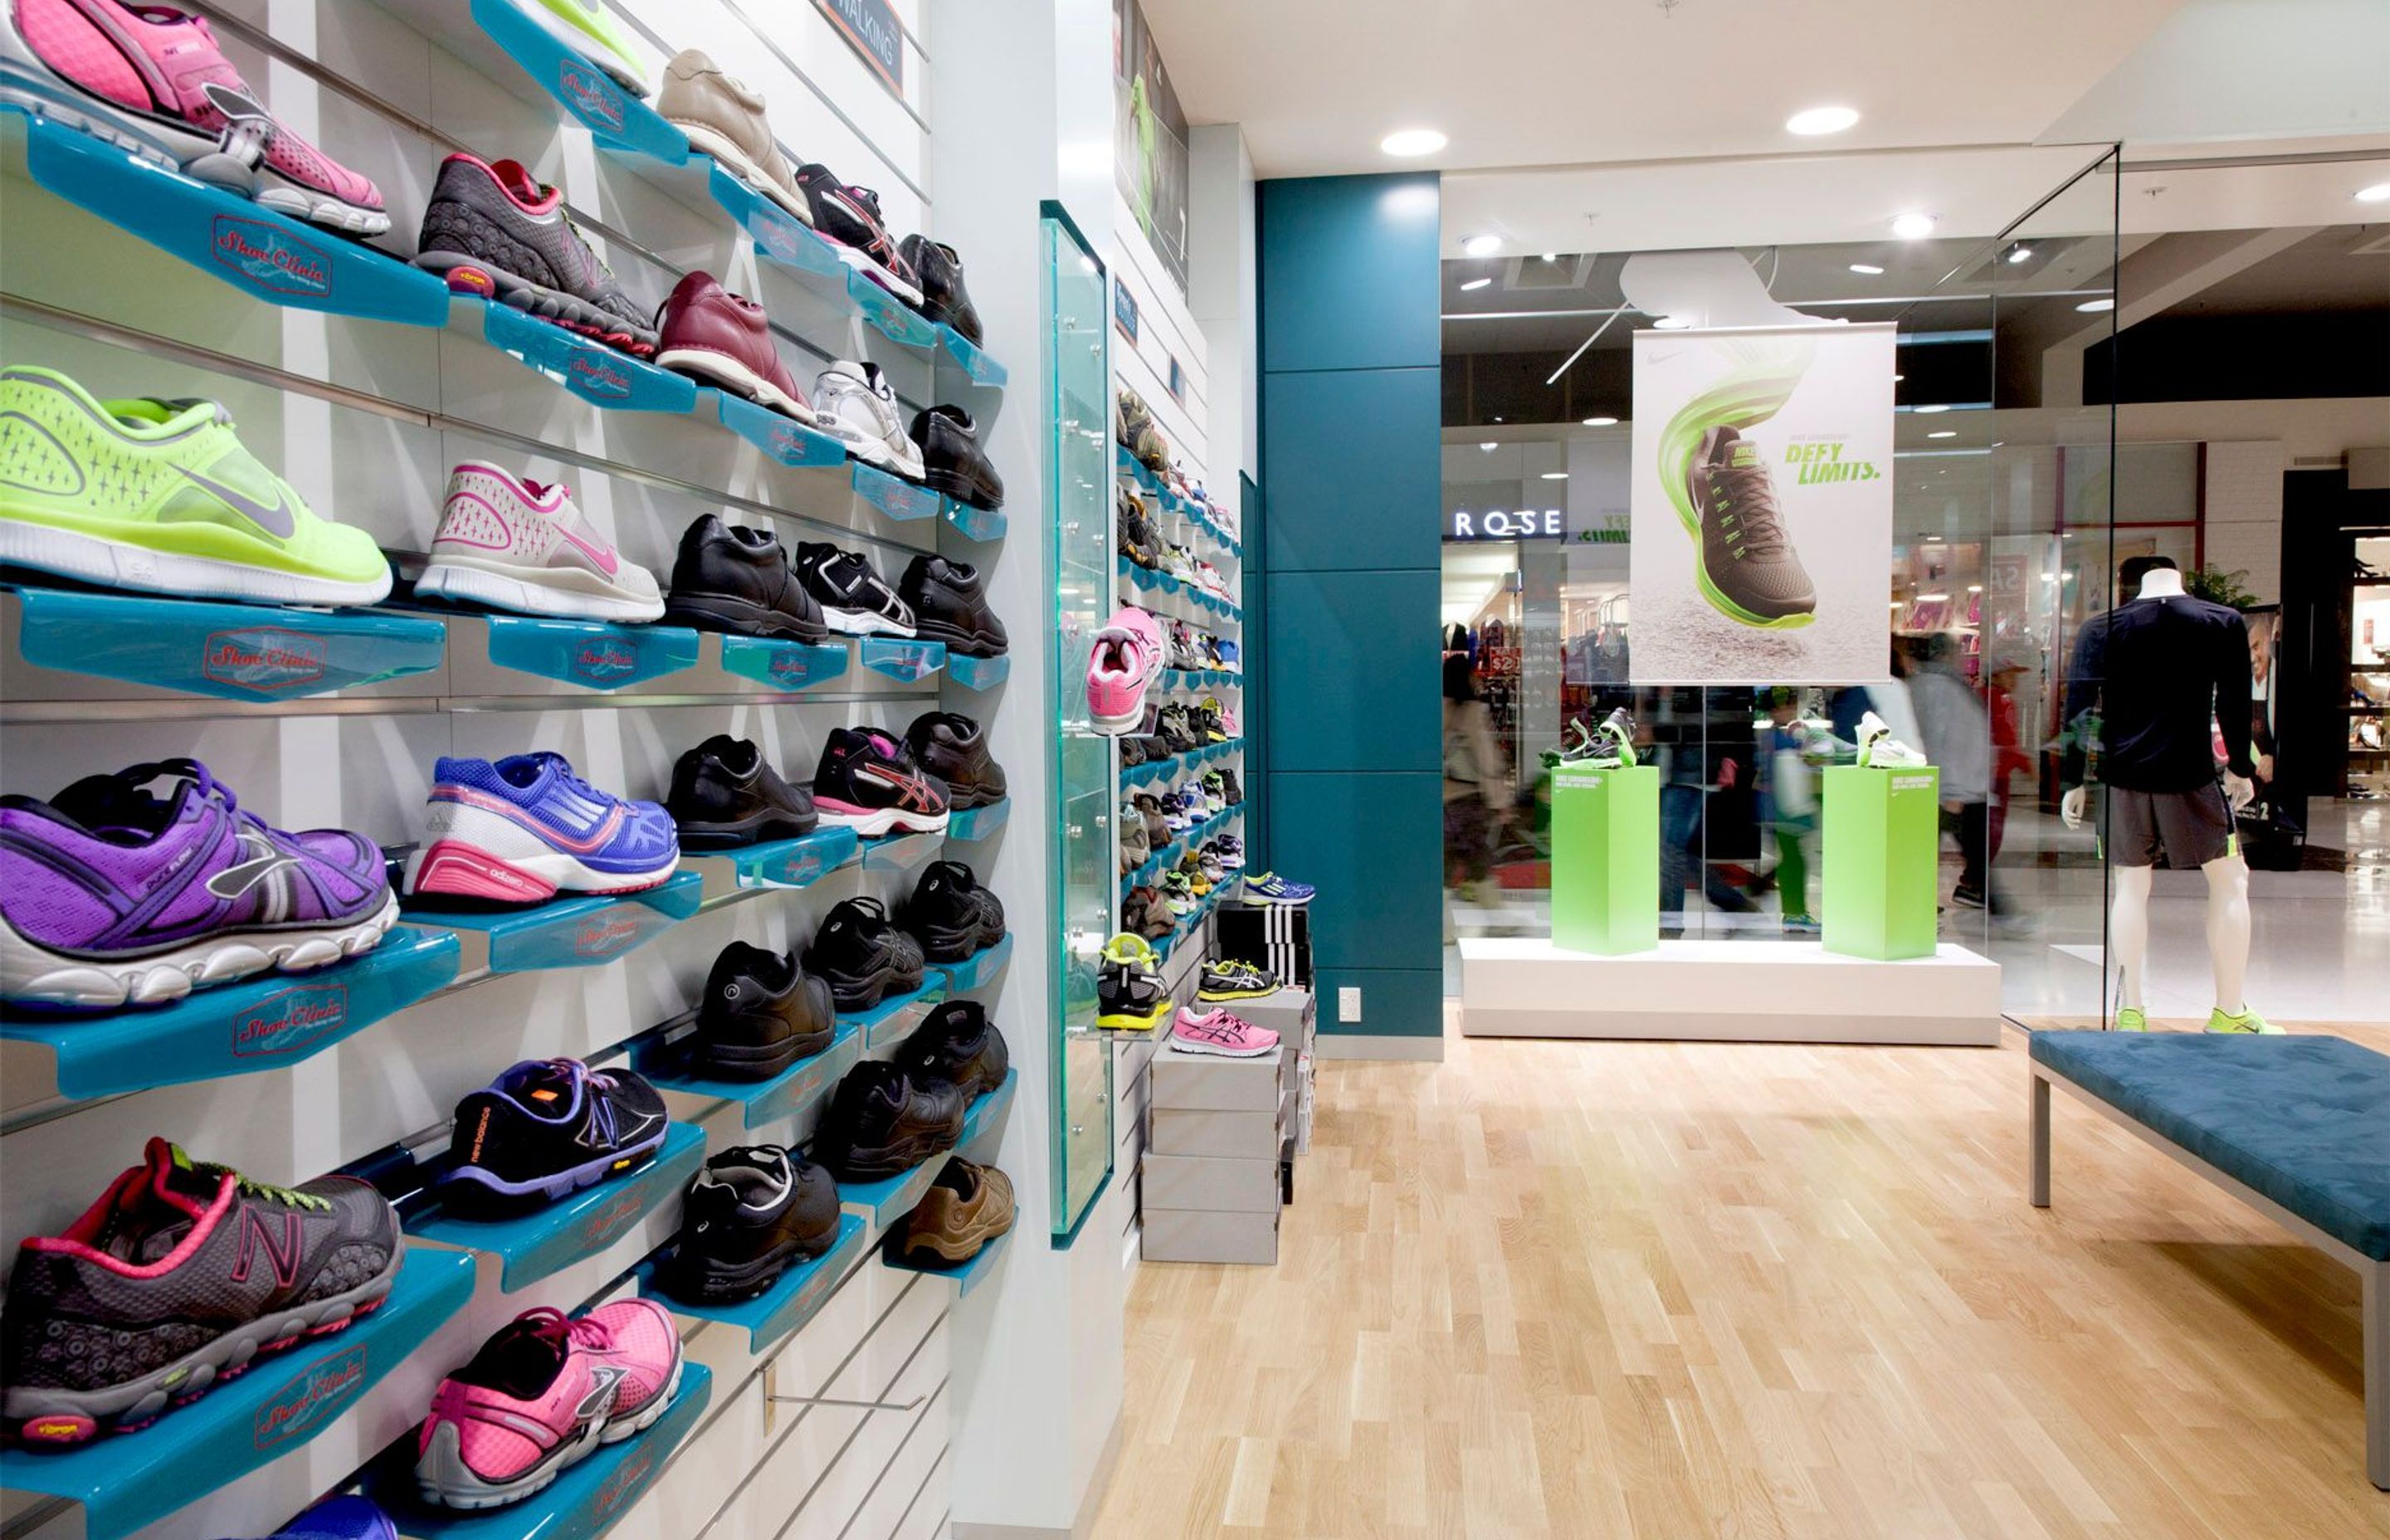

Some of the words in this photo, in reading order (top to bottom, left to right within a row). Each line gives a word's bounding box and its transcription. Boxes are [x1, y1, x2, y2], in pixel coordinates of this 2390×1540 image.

[218, 231, 269, 263] Shoe
[272, 249, 324, 282] Clinic
[1784, 443, 1844, 465] DEFY
[1797, 461, 1881, 485] LIMITS.
[1455, 509, 1561, 536] ROSE
[212, 646, 262, 667] Shoe
[266, 647, 318, 667] Clinic
[490, 868, 524, 887] adizero
[239, 1020, 288, 1042] Shoe
[290, 998, 342, 1027] Clinic
[474, 1106, 491, 1143] balance
[471, 1143, 481, 1162] new
